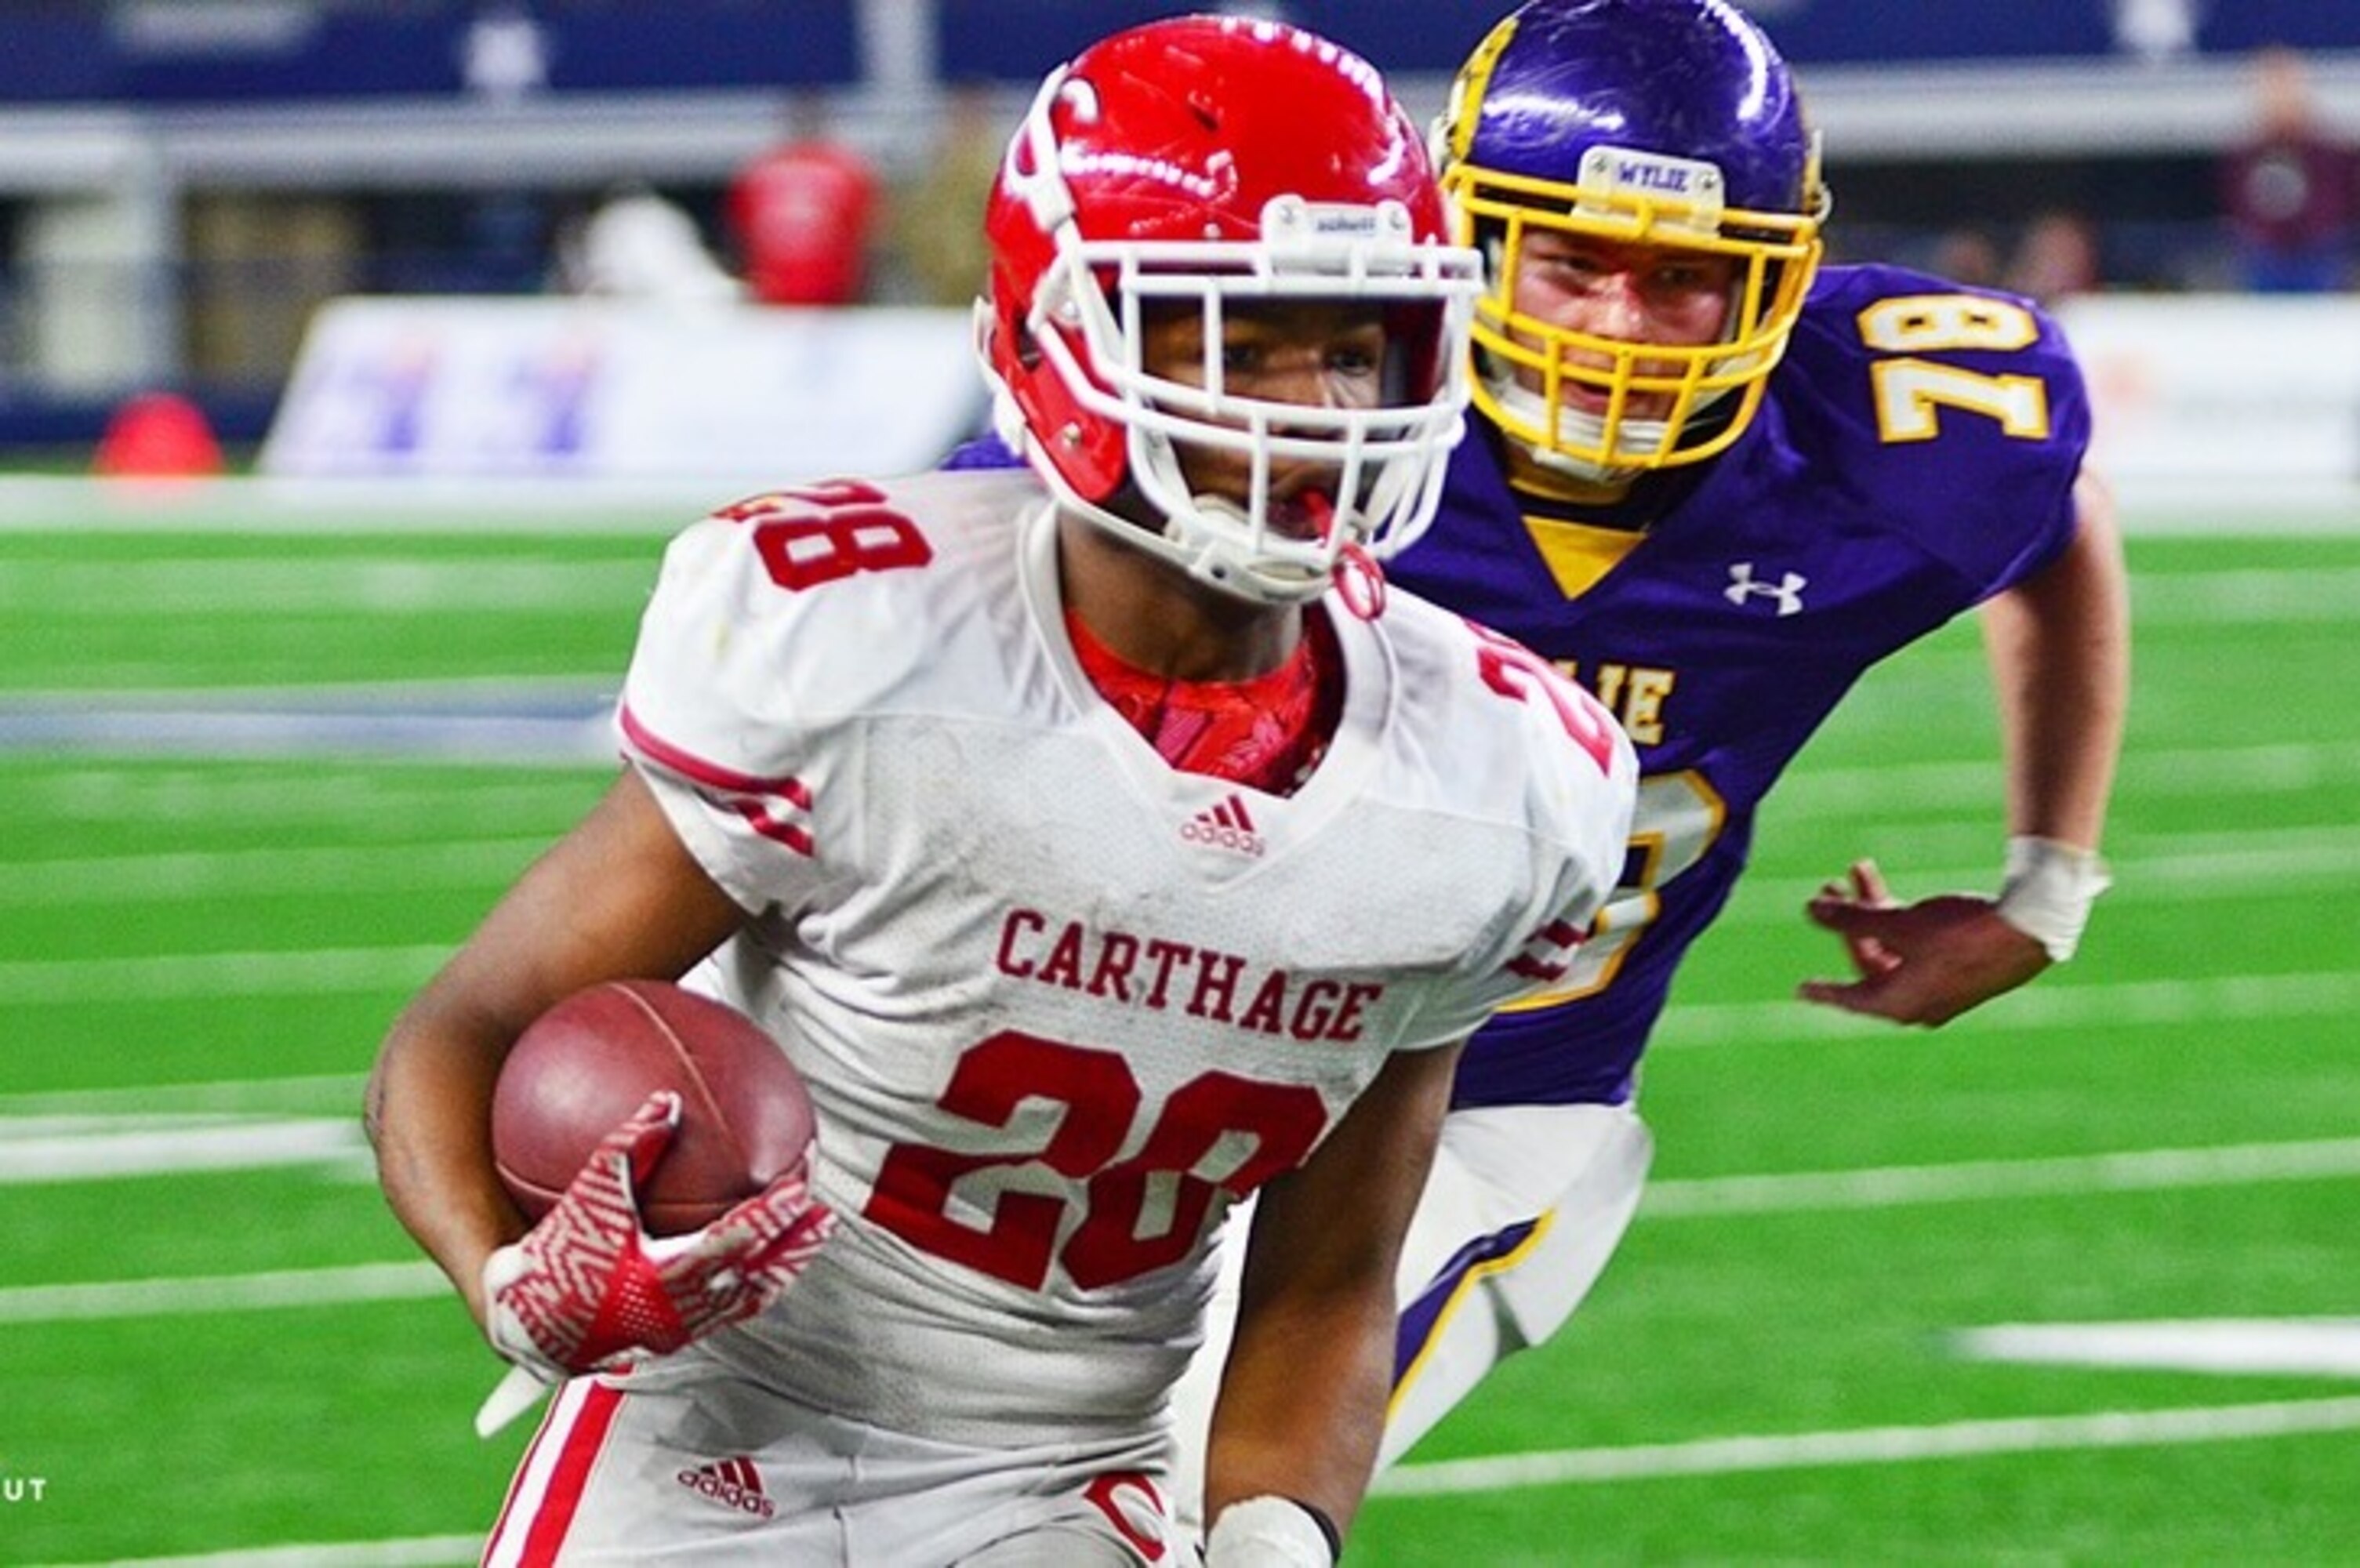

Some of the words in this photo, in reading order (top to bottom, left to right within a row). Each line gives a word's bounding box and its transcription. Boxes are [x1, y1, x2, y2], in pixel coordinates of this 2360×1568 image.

[1618, 162, 1690, 192] WYLIE
[1855, 293, 2050, 444] 78
[708, 477, 935, 593] 28
[1180, 822, 1265, 858] adidas
[996, 908, 1383, 1043] CARTHAGE
[862, 1029, 1330, 1294] 28
[677, 1469, 775, 1518] adidas
